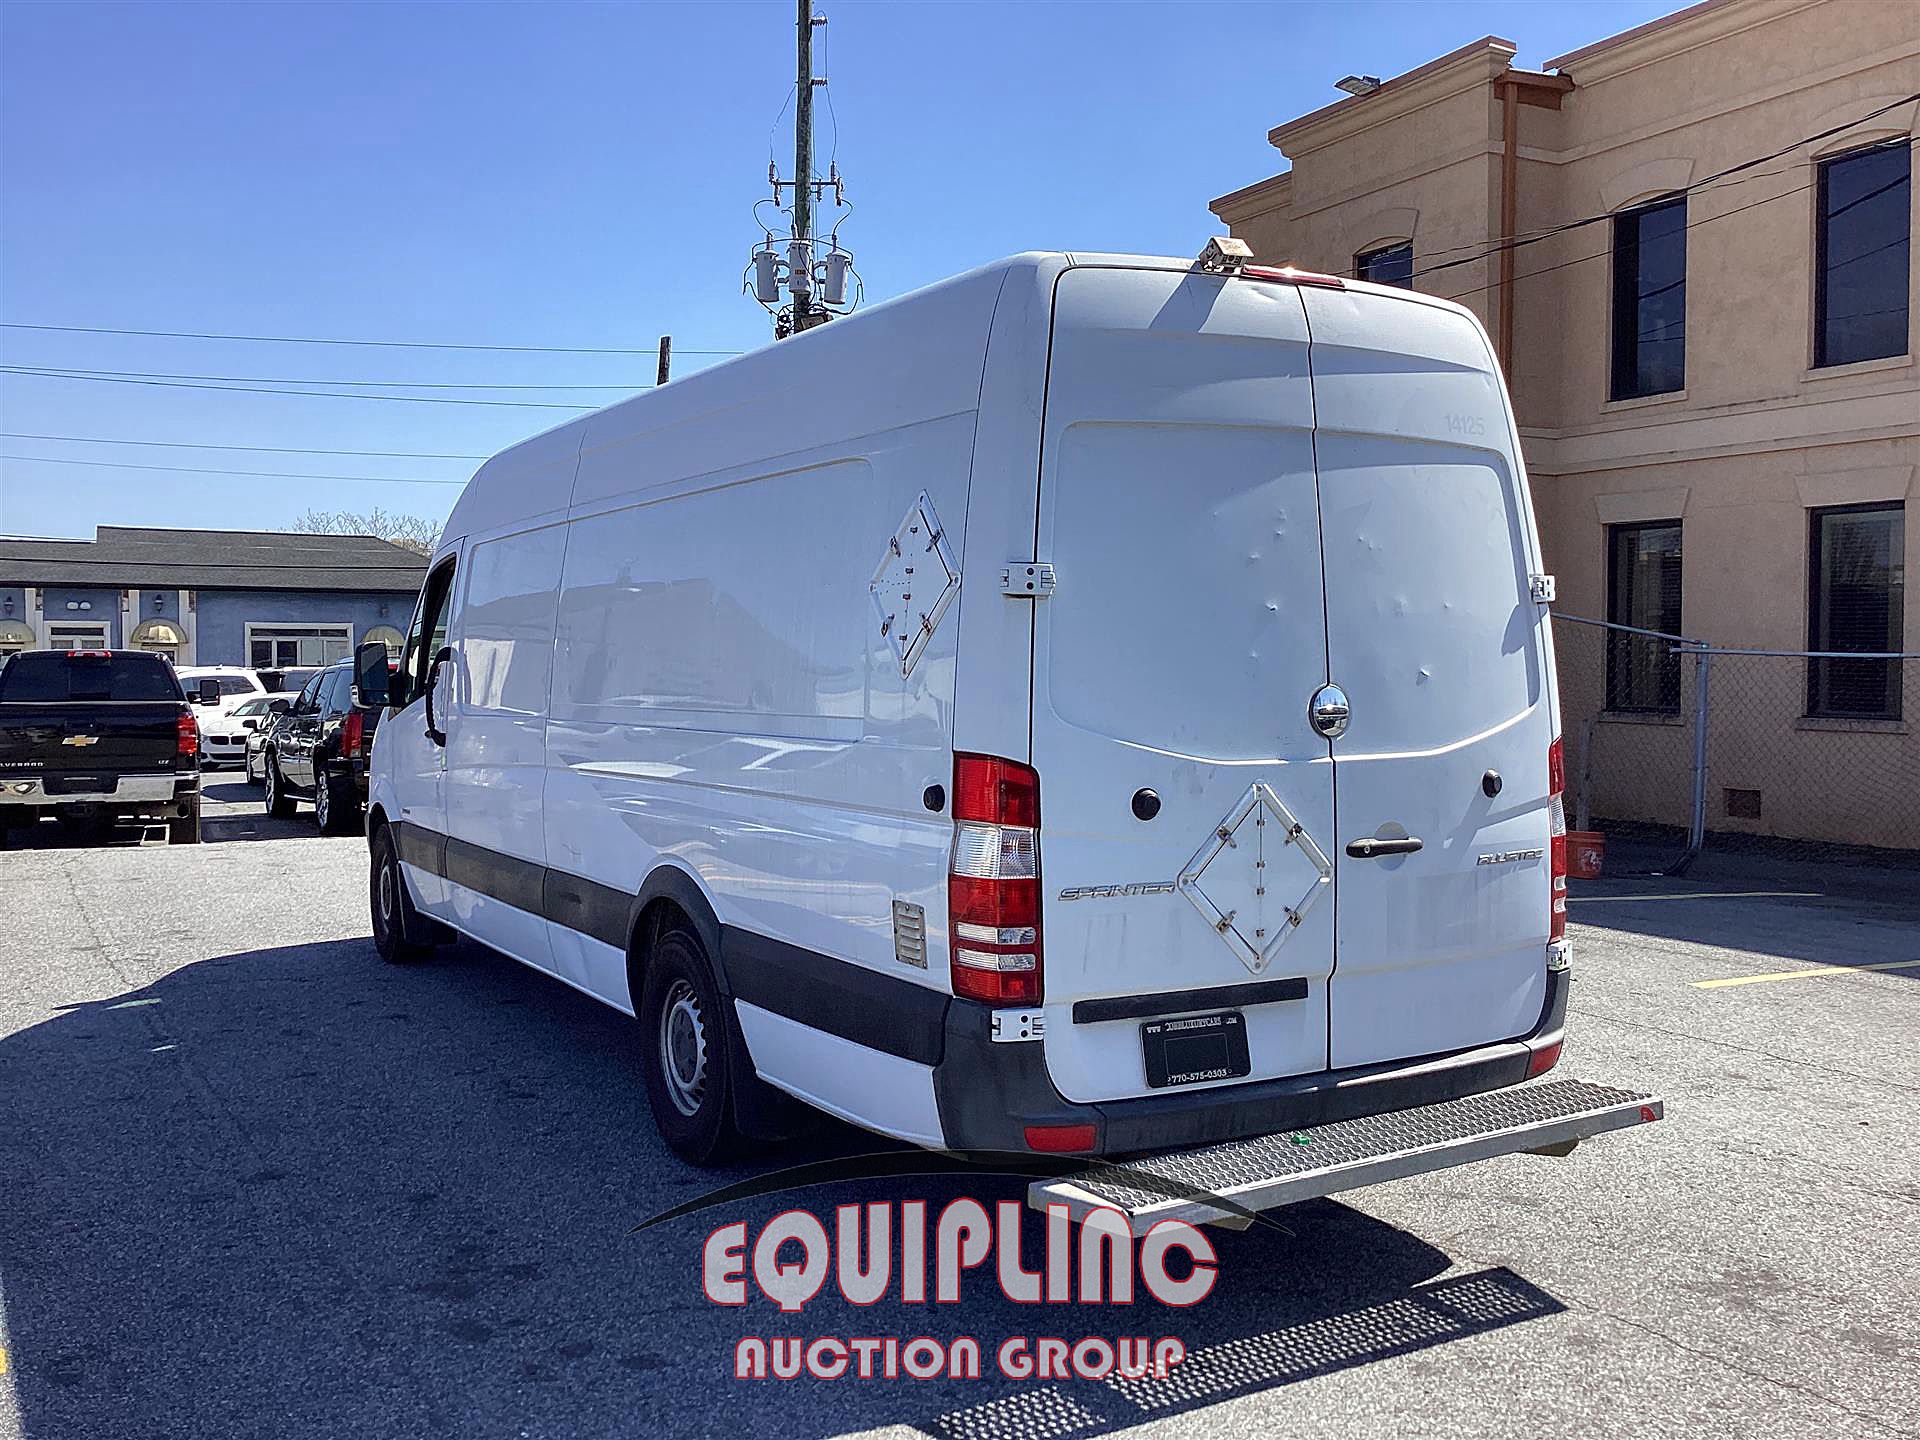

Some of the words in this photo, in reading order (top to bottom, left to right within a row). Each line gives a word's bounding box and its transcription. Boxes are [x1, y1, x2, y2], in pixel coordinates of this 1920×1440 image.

[1445, 414, 1486, 435] 14125
[1058, 881, 1176, 902] SPRINTER
[1171, 1068, 1227, 1084] 770-575-0303
